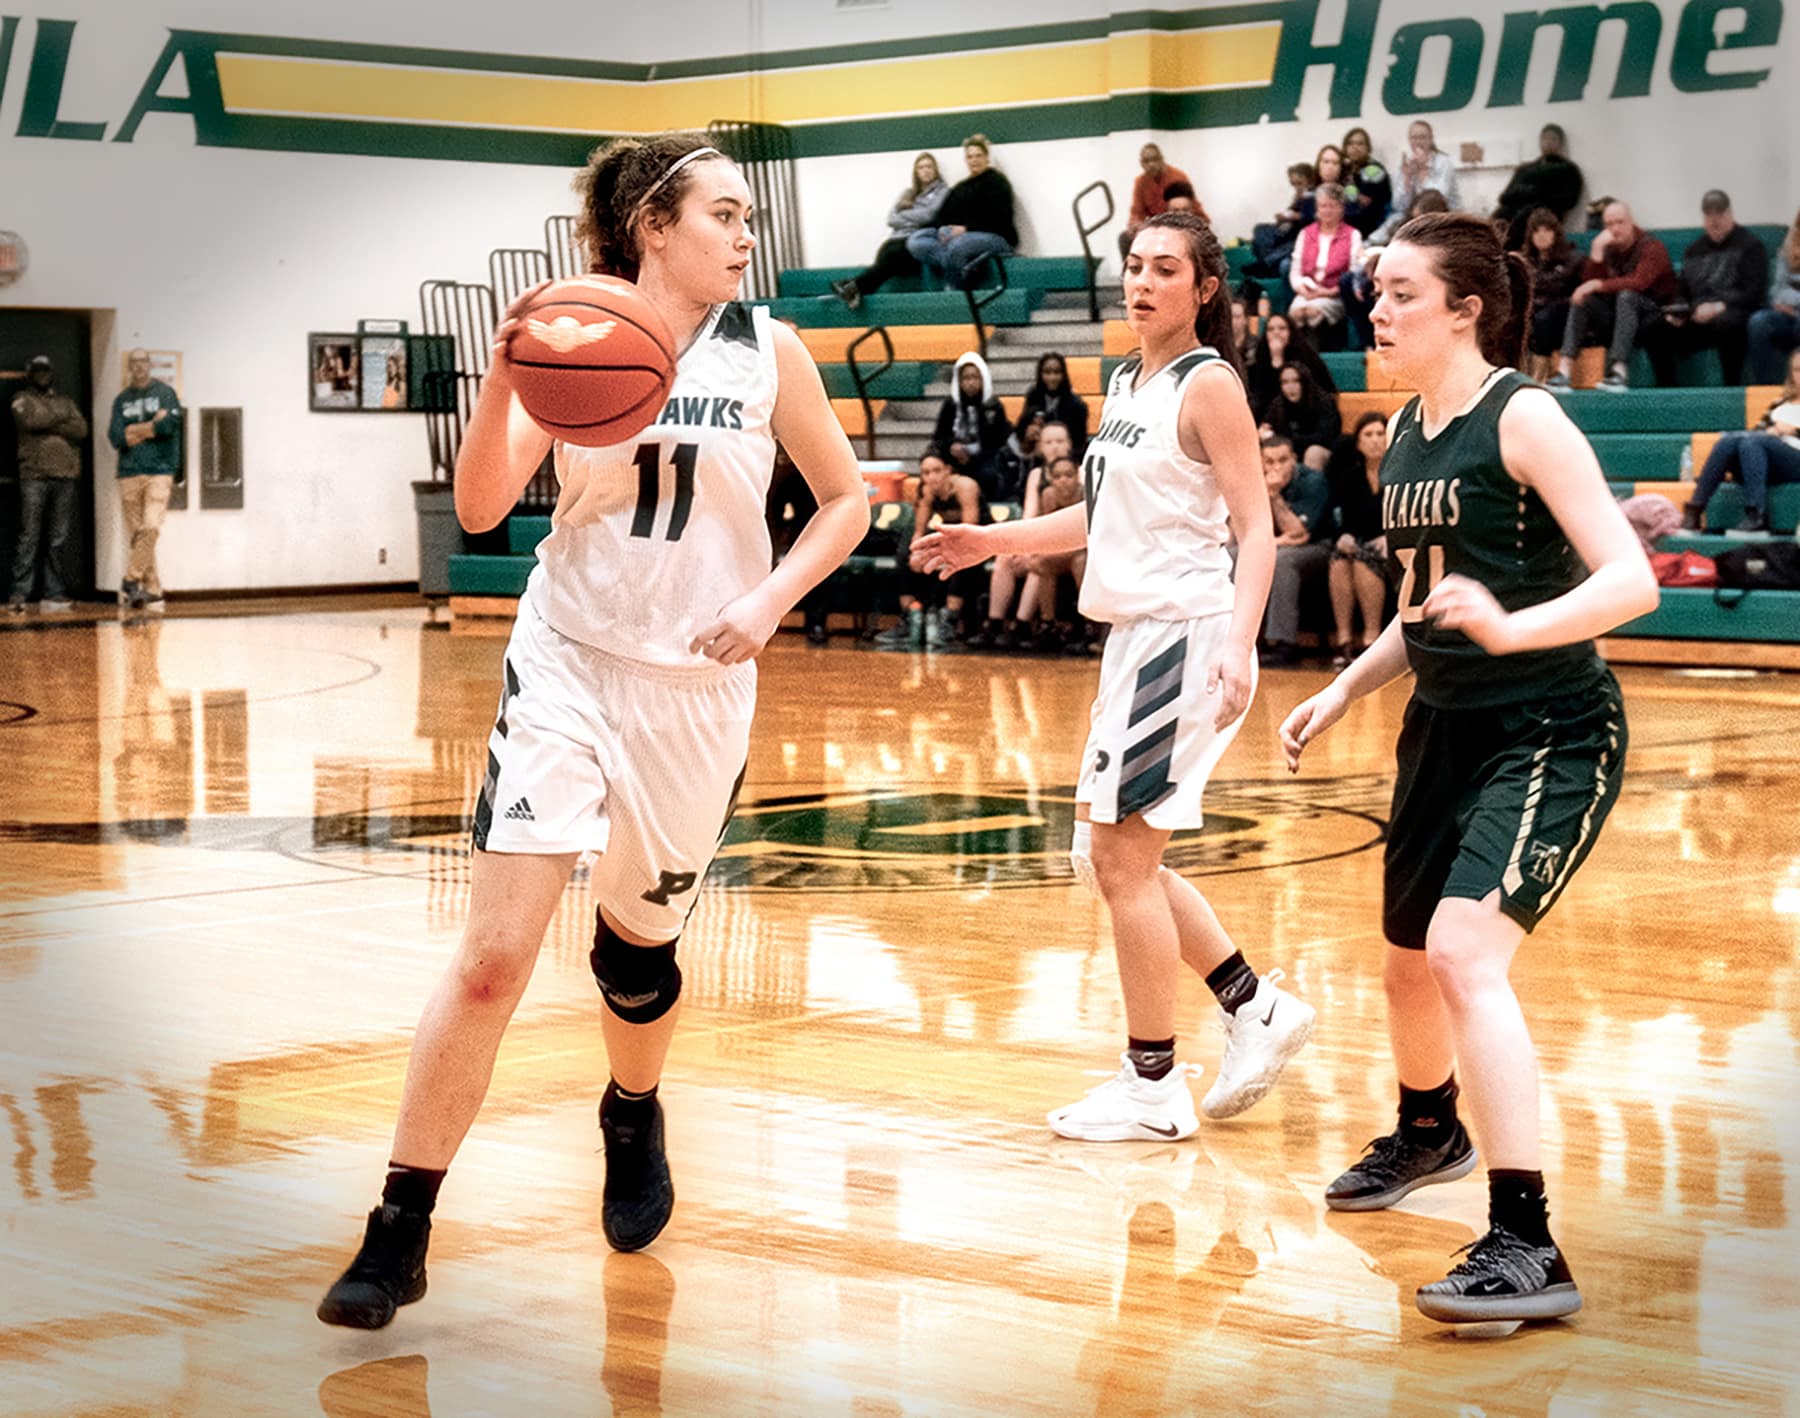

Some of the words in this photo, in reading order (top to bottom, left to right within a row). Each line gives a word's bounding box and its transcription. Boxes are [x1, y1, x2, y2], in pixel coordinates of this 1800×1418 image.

[0, 16, 224, 147] LA
[1262, 0, 1784, 123] Home
[653, 397, 745, 431] AWKS
[630, 443, 699, 541] 11
[640, 869, 697, 906] P
